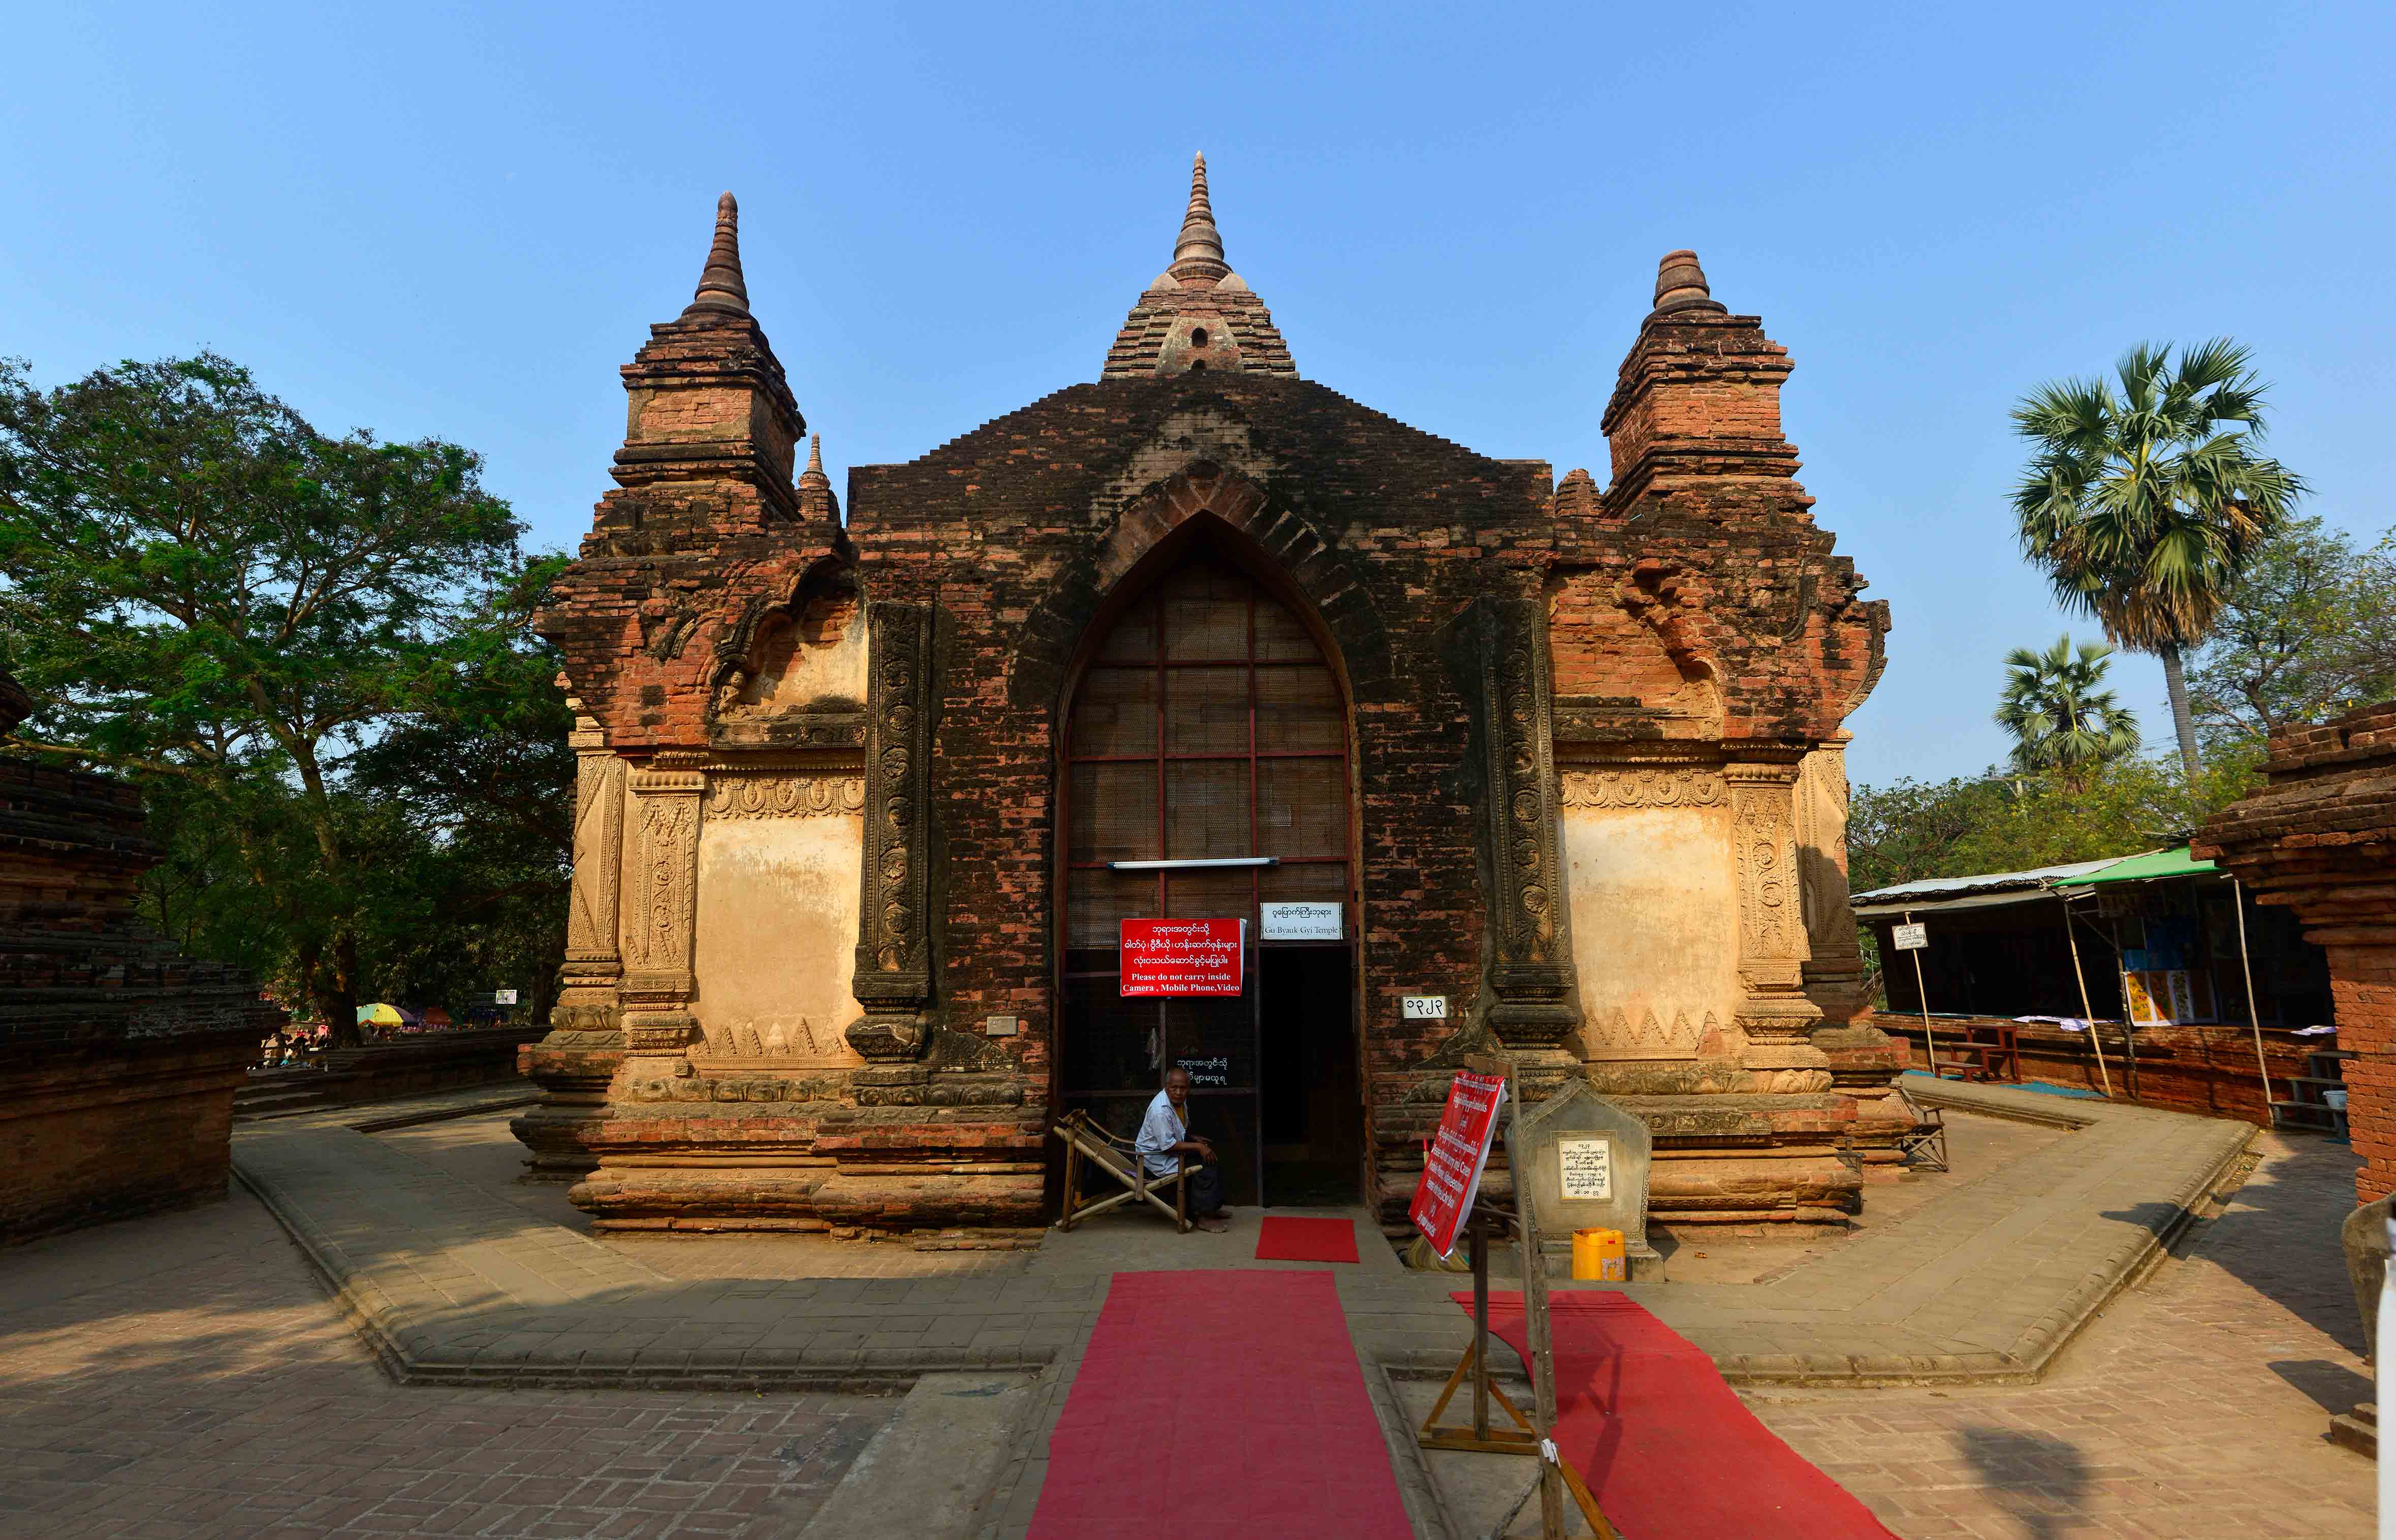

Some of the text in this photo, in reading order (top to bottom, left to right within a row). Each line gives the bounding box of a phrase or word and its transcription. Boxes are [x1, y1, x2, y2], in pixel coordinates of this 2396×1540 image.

[1278, 927, 1298, 935] Byauk
[1300, 927, 1313, 935] Gyi
[1314, 926, 1338, 935] Temple
